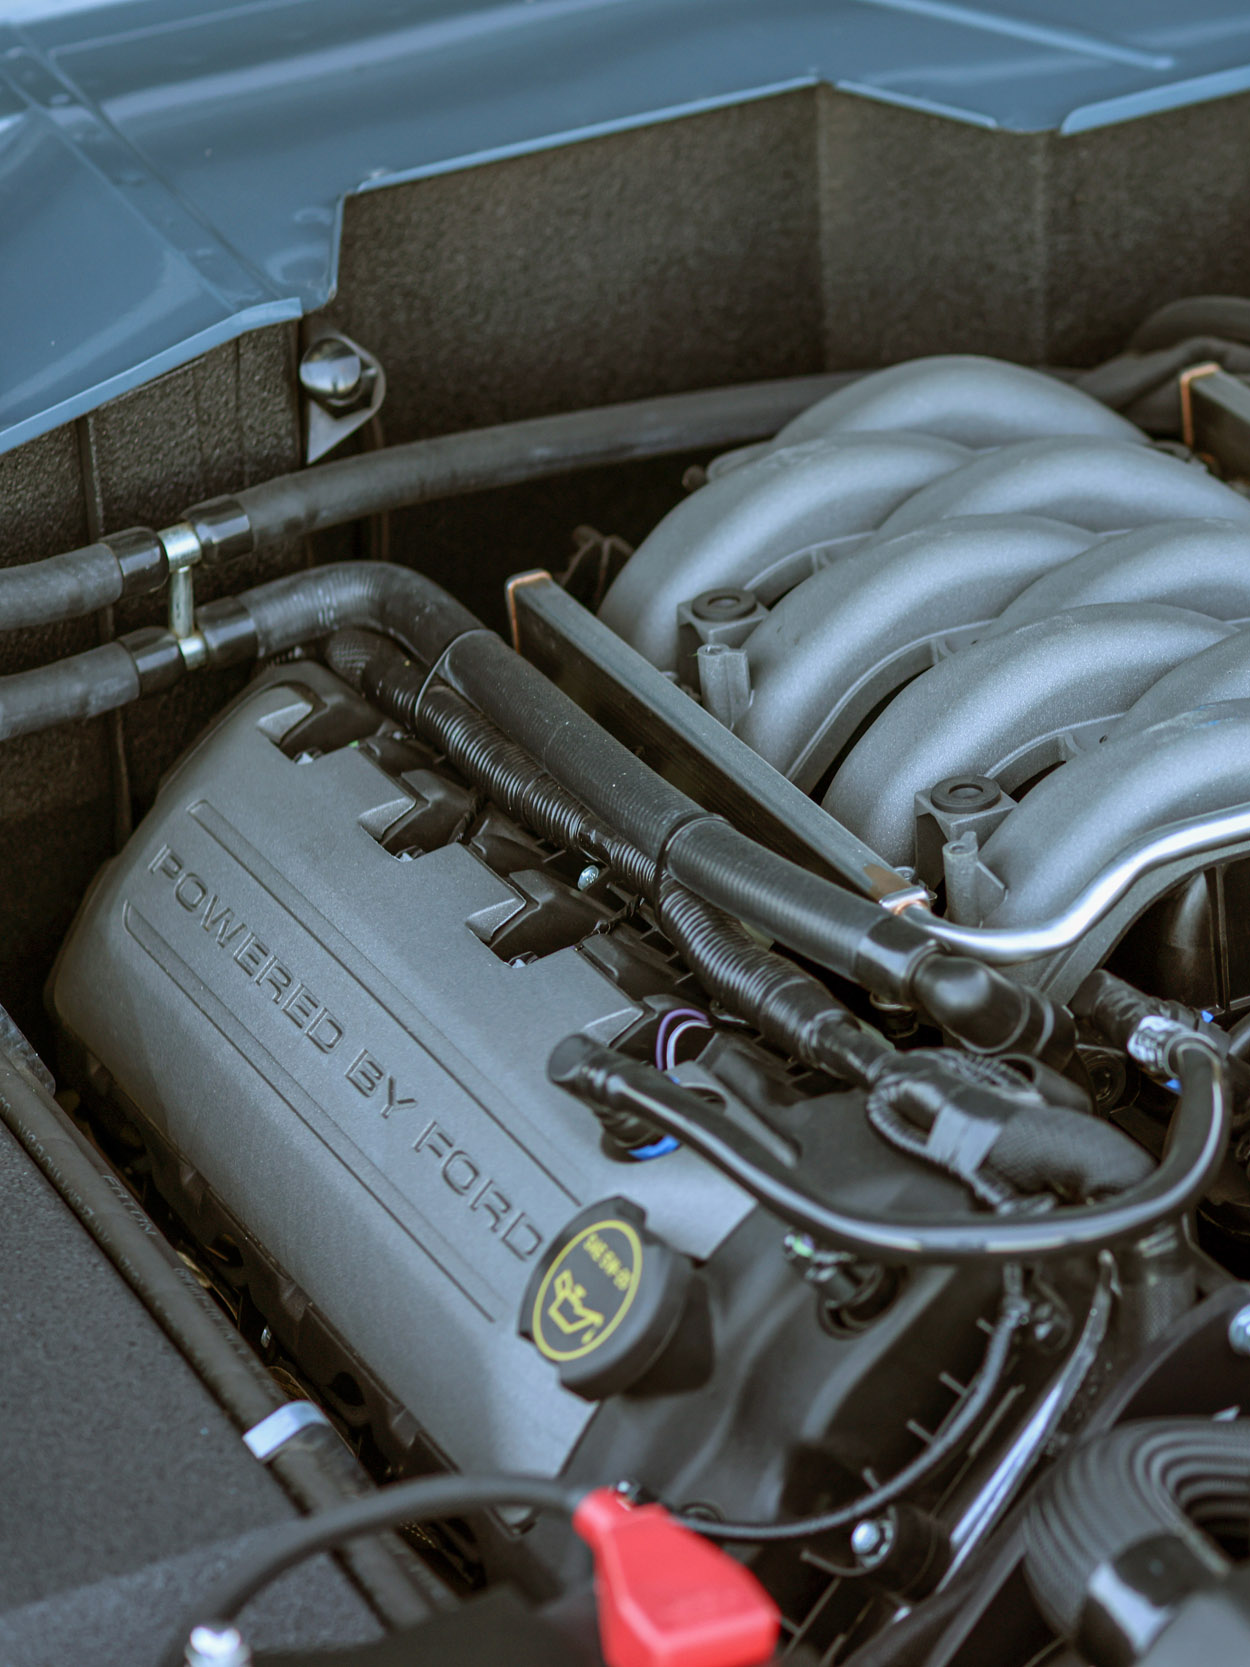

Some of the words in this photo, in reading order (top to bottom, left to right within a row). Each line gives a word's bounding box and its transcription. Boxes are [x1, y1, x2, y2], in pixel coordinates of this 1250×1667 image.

[148, 843, 344, 1054] POWERED
[344, 1048, 417, 1119] BY
[412, 1120, 543, 1262] FORD
